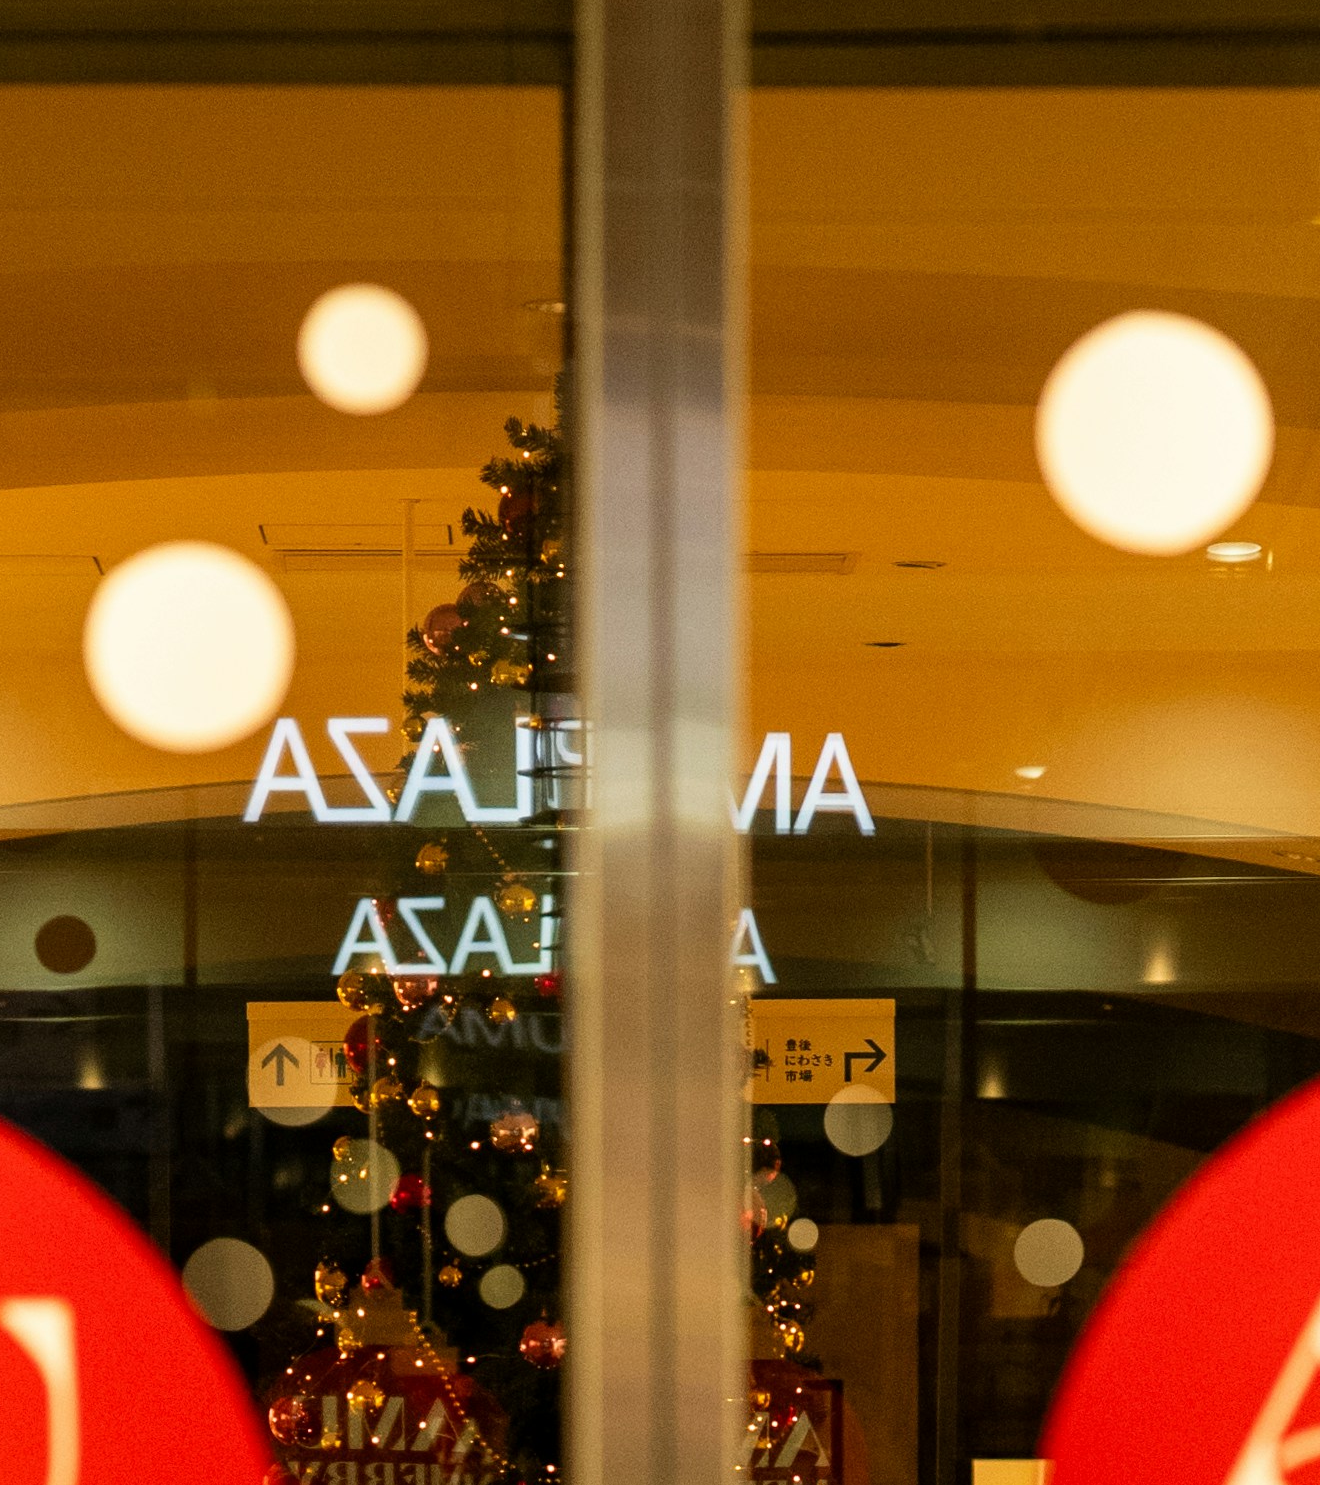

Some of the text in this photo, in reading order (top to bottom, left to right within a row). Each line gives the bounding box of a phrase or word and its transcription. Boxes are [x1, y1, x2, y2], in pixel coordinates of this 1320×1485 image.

[785, 1039, 811, 1052] 豊後
[784, 1054, 833, 1067] にわさき
[785, 1070, 812, 1082] 市場
